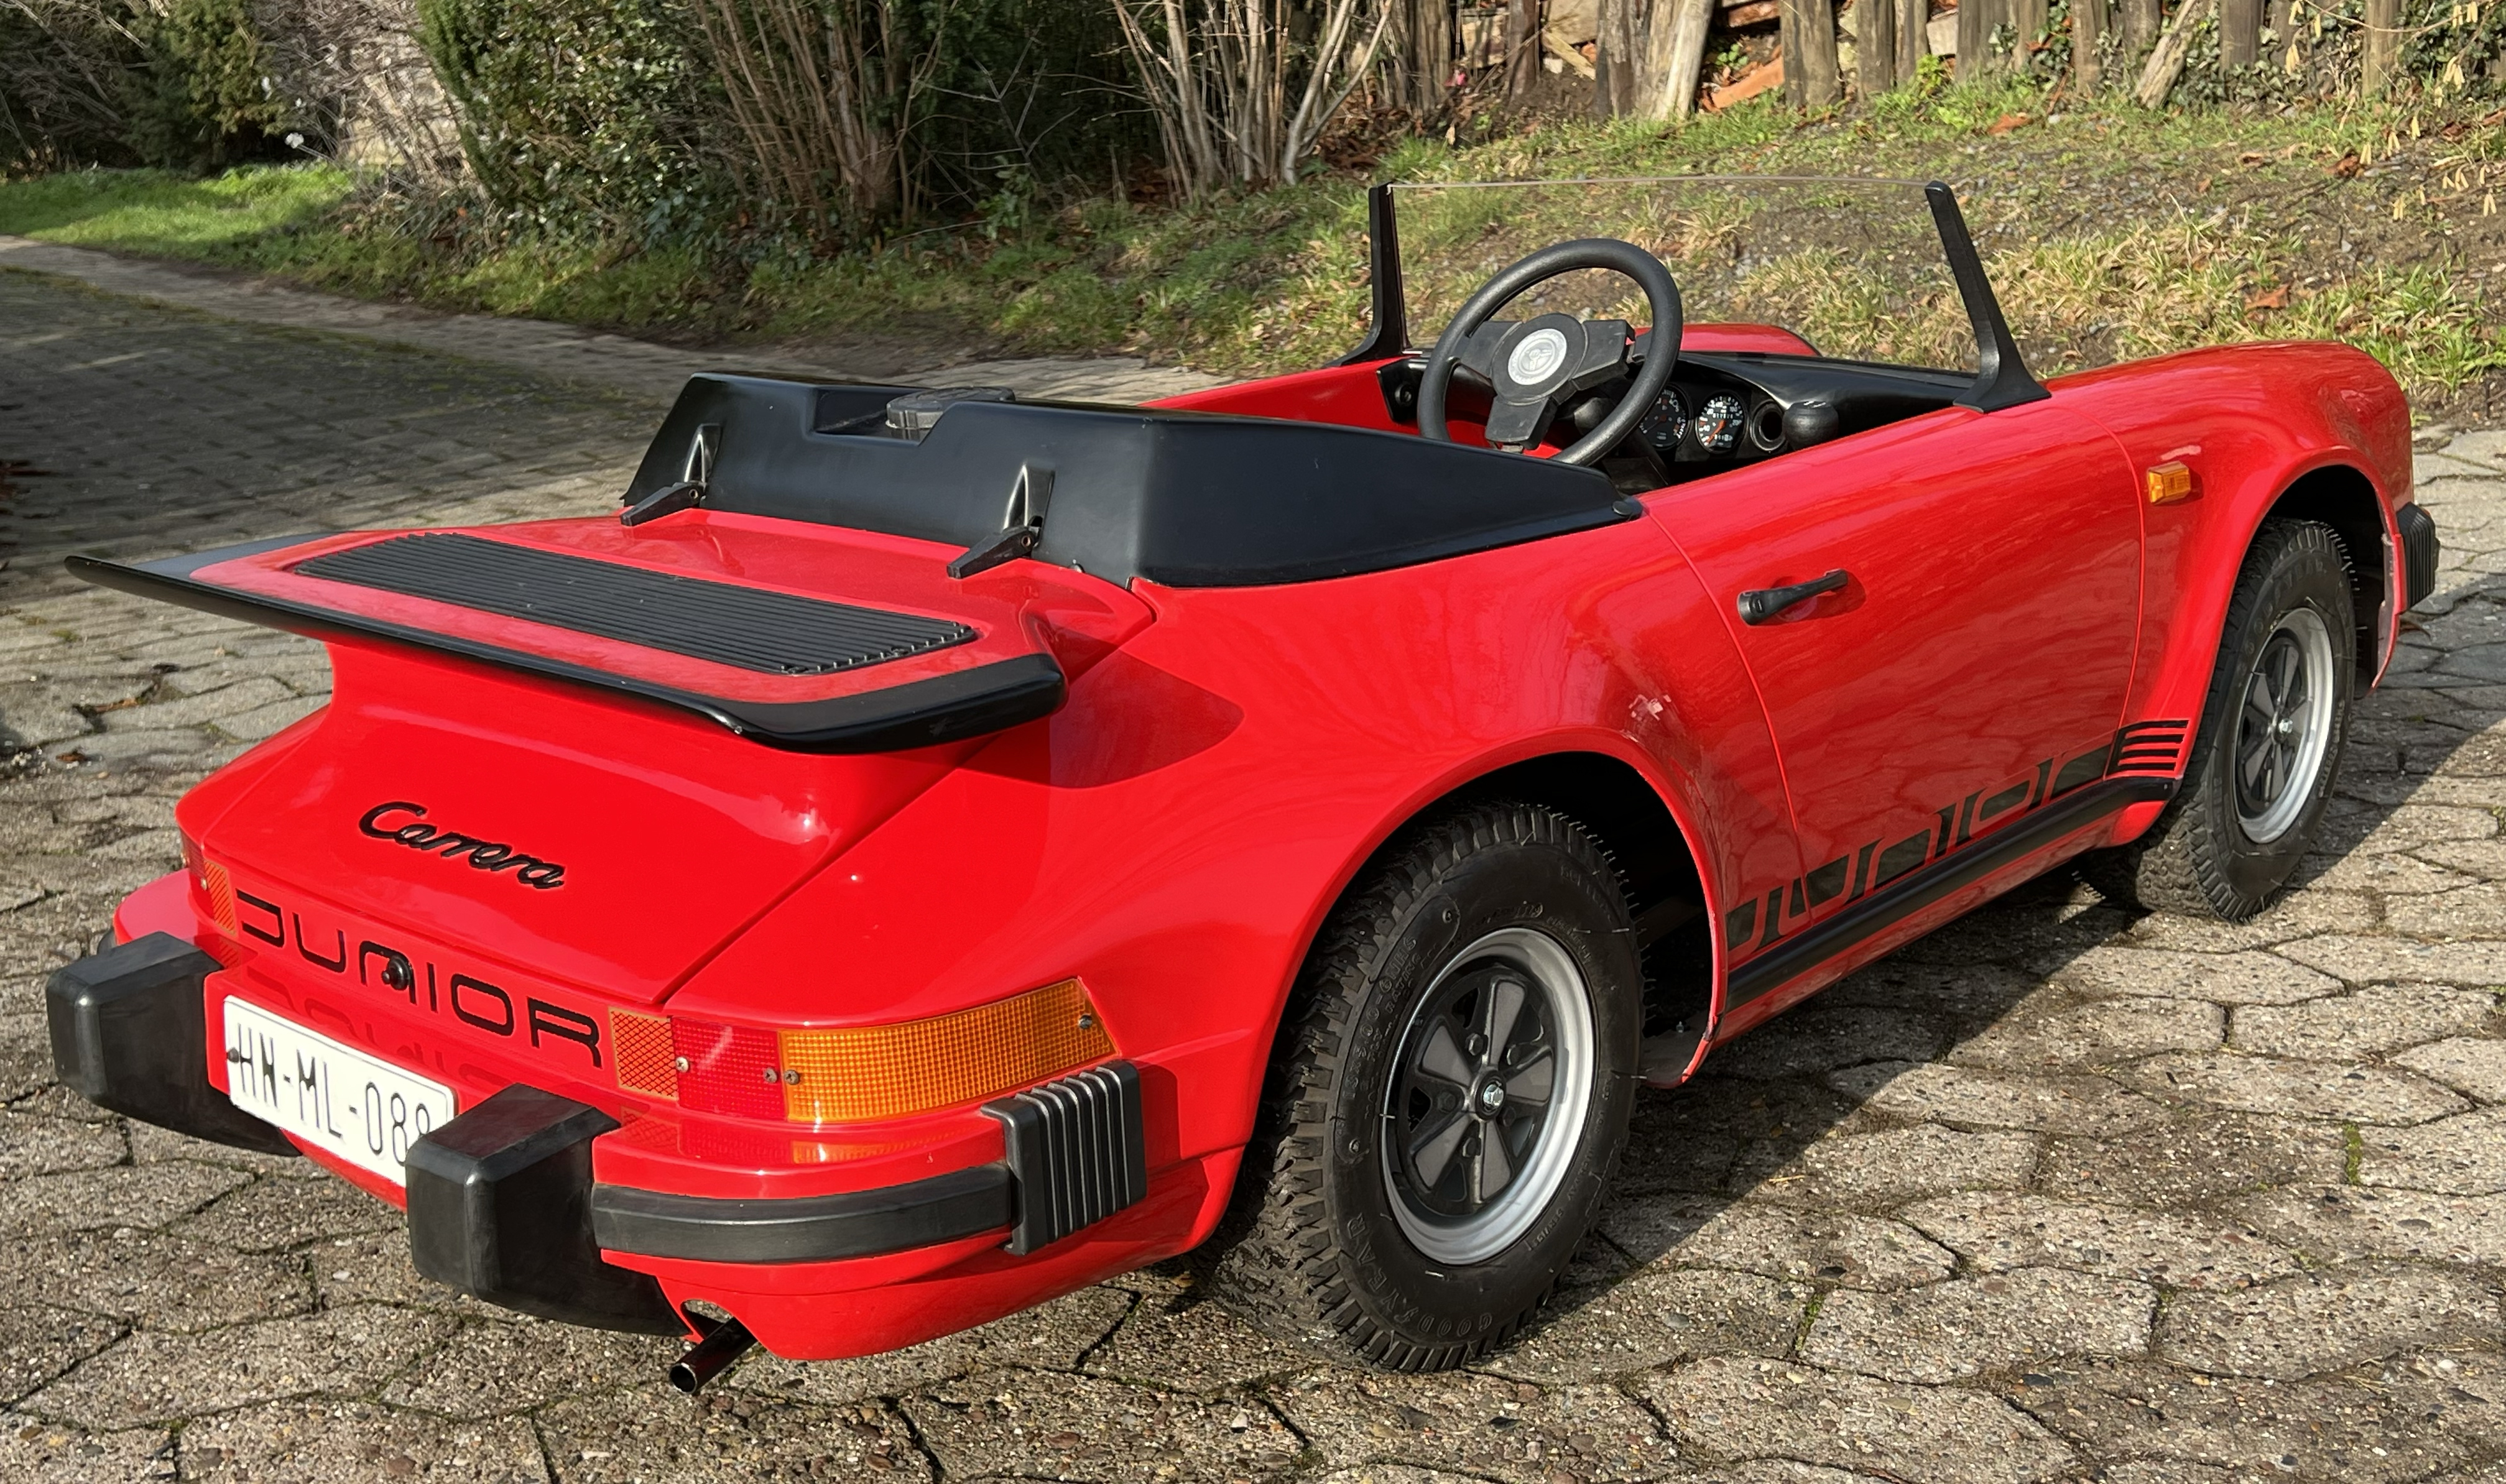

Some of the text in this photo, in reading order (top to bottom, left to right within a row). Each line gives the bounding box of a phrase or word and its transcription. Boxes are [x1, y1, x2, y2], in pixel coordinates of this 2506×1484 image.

[359, 801, 566, 889] Carrera
[236, 888, 603, 1069] JUNIOR
[1347, 1212, 1493, 1339] GOODYEAR
